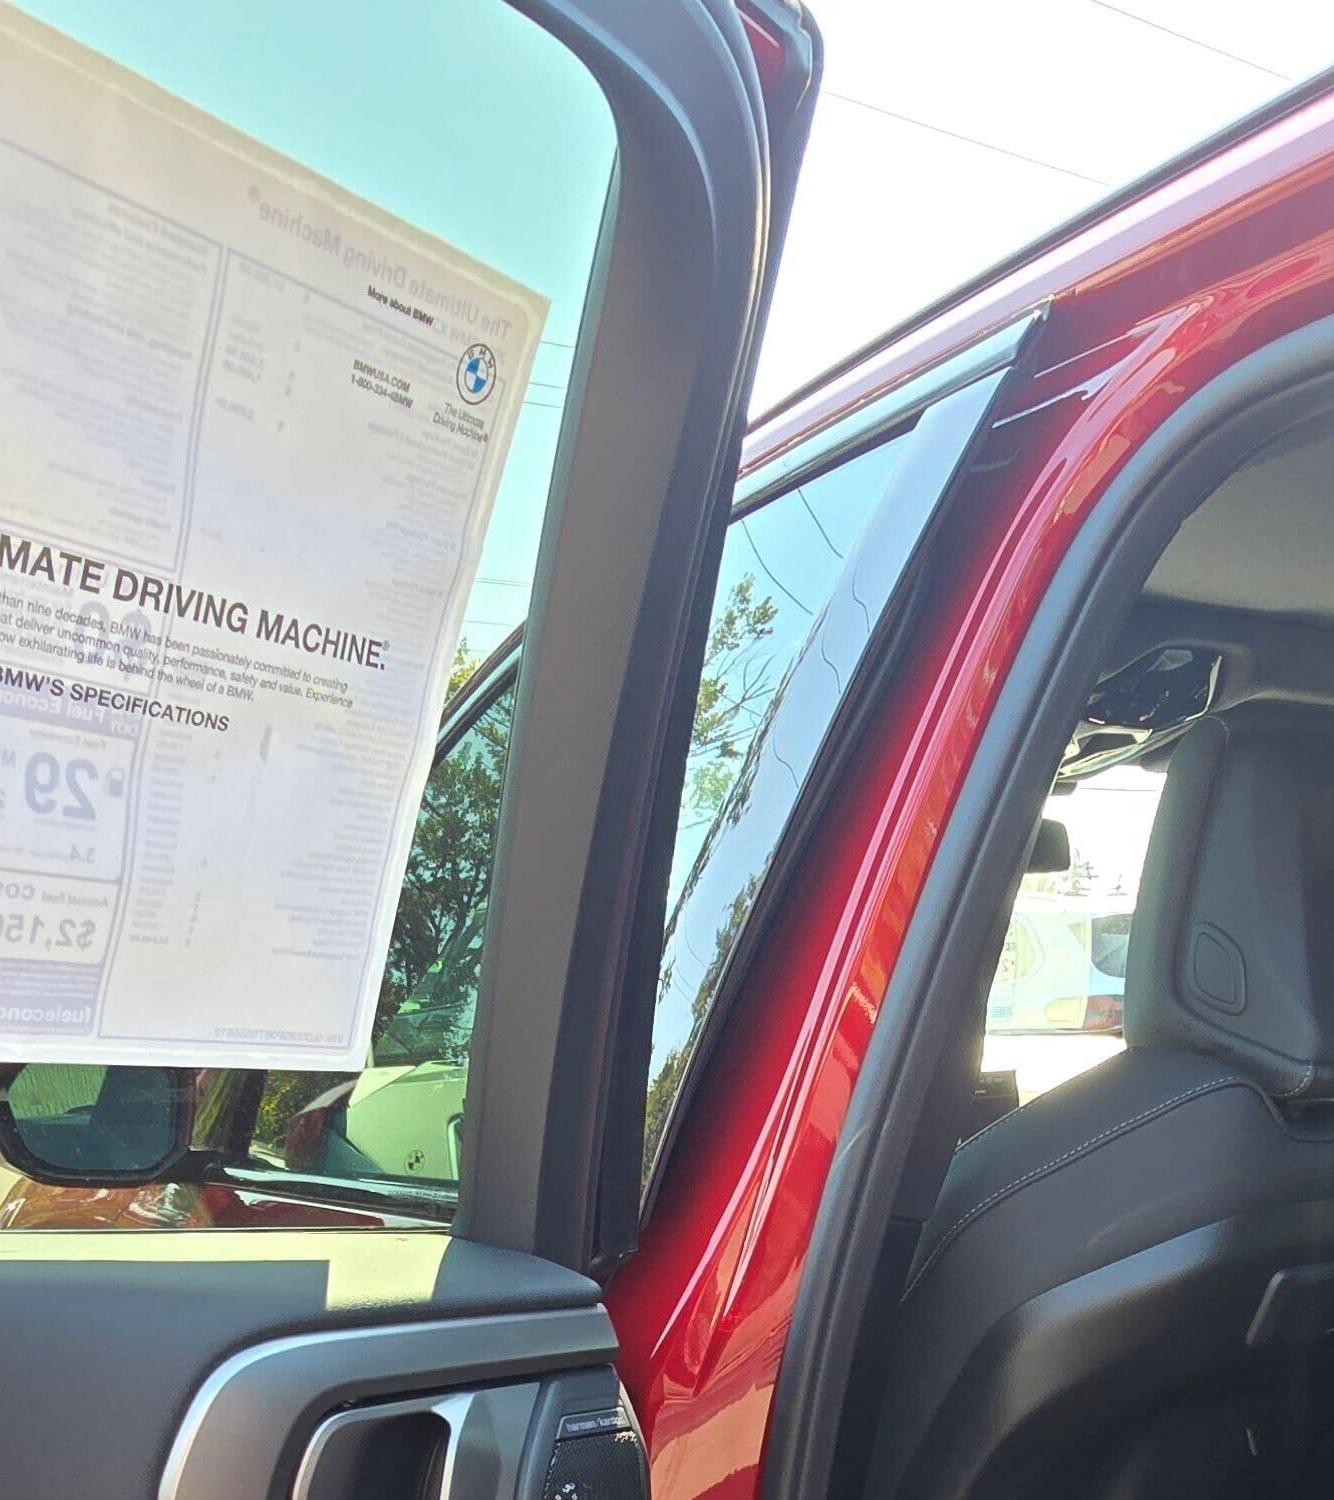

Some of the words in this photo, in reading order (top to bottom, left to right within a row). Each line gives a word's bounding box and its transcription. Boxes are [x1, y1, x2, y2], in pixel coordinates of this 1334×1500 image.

[389, 297, 412, 317] about
[413, 308, 434, 327] BMW
[112, 568, 248, 634] DRIVING
[16, 616, 55, 635] deliver
[57, 628, 120, 652] uncommon
[123, 645, 160, 665] quality,
[163, 654, 227, 680] performance,
[229, 669, 258, 688] safety
[260, 678, 277, 692] and
[305, 687, 354, 709] Experience
[19, 636, 85, 664] exhilarating
[87, 651, 104, 666] life
[107, 655, 116, 670] is
[118, 659, 155, 679] behind
[157, 669, 174, 683] the
[176, 674, 204, 691] wheel
[206, 680, 216, 693] of
[218, 685, 225, 695] a
[226, 684, 255, 702] BMW.
[27, 601, 52, 617] nine
[54, 607, 106, 633] decades,
[110, 621, 141, 641] BMW
[143, 631, 162, 646] has
[165, 636, 190, 652] been
[192, 644, 252, 670] passionately
[253, 660, 302, 681] committed
[303, 671, 312, 683] to
[313, 675, 348, 695] creating
[69, 683, 231, 732] SPECIFICATIONS
